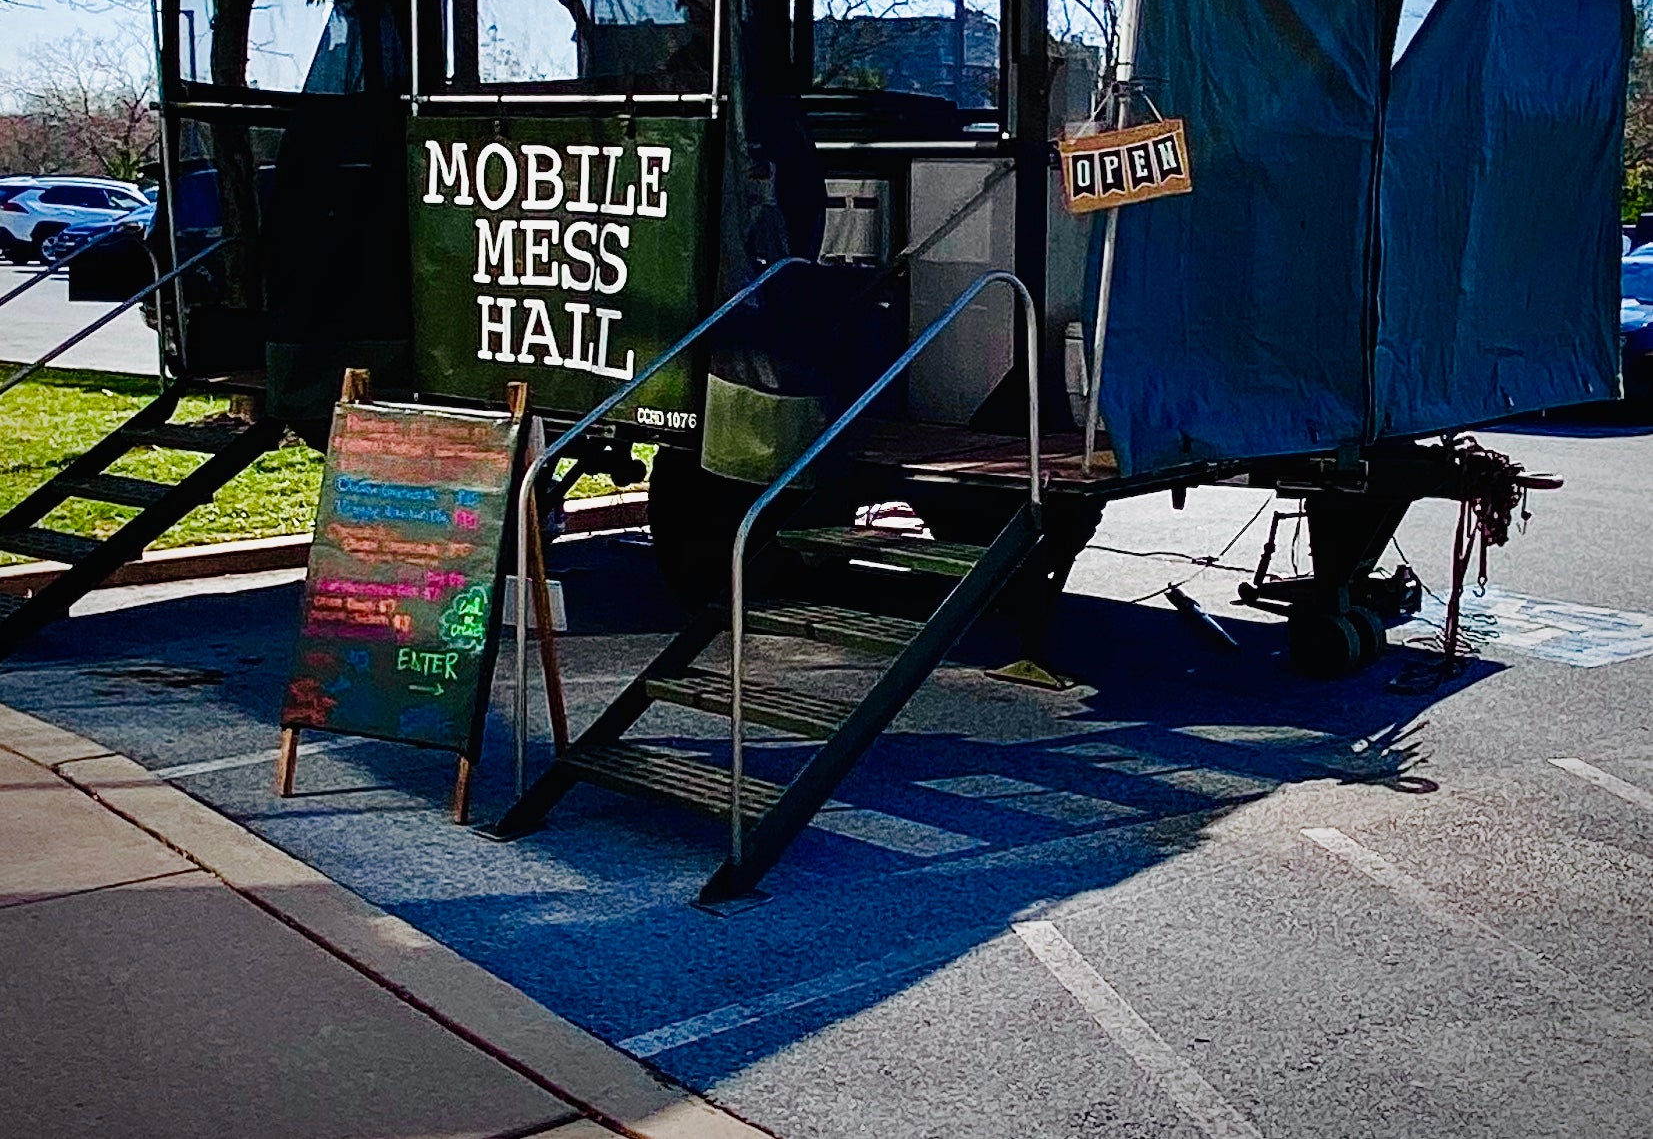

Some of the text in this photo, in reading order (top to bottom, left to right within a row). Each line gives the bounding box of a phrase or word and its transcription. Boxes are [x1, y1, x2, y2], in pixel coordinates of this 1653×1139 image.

[423, 139, 672, 218] MOBILE
[1076, 140, 1178, 188] OPEN
[473, 218, 630, 295] MESS
[477, 295, 635, 381] HALL
[666, 411, 698, 429] 1076
[396, 647, 459, 680] ENTER
